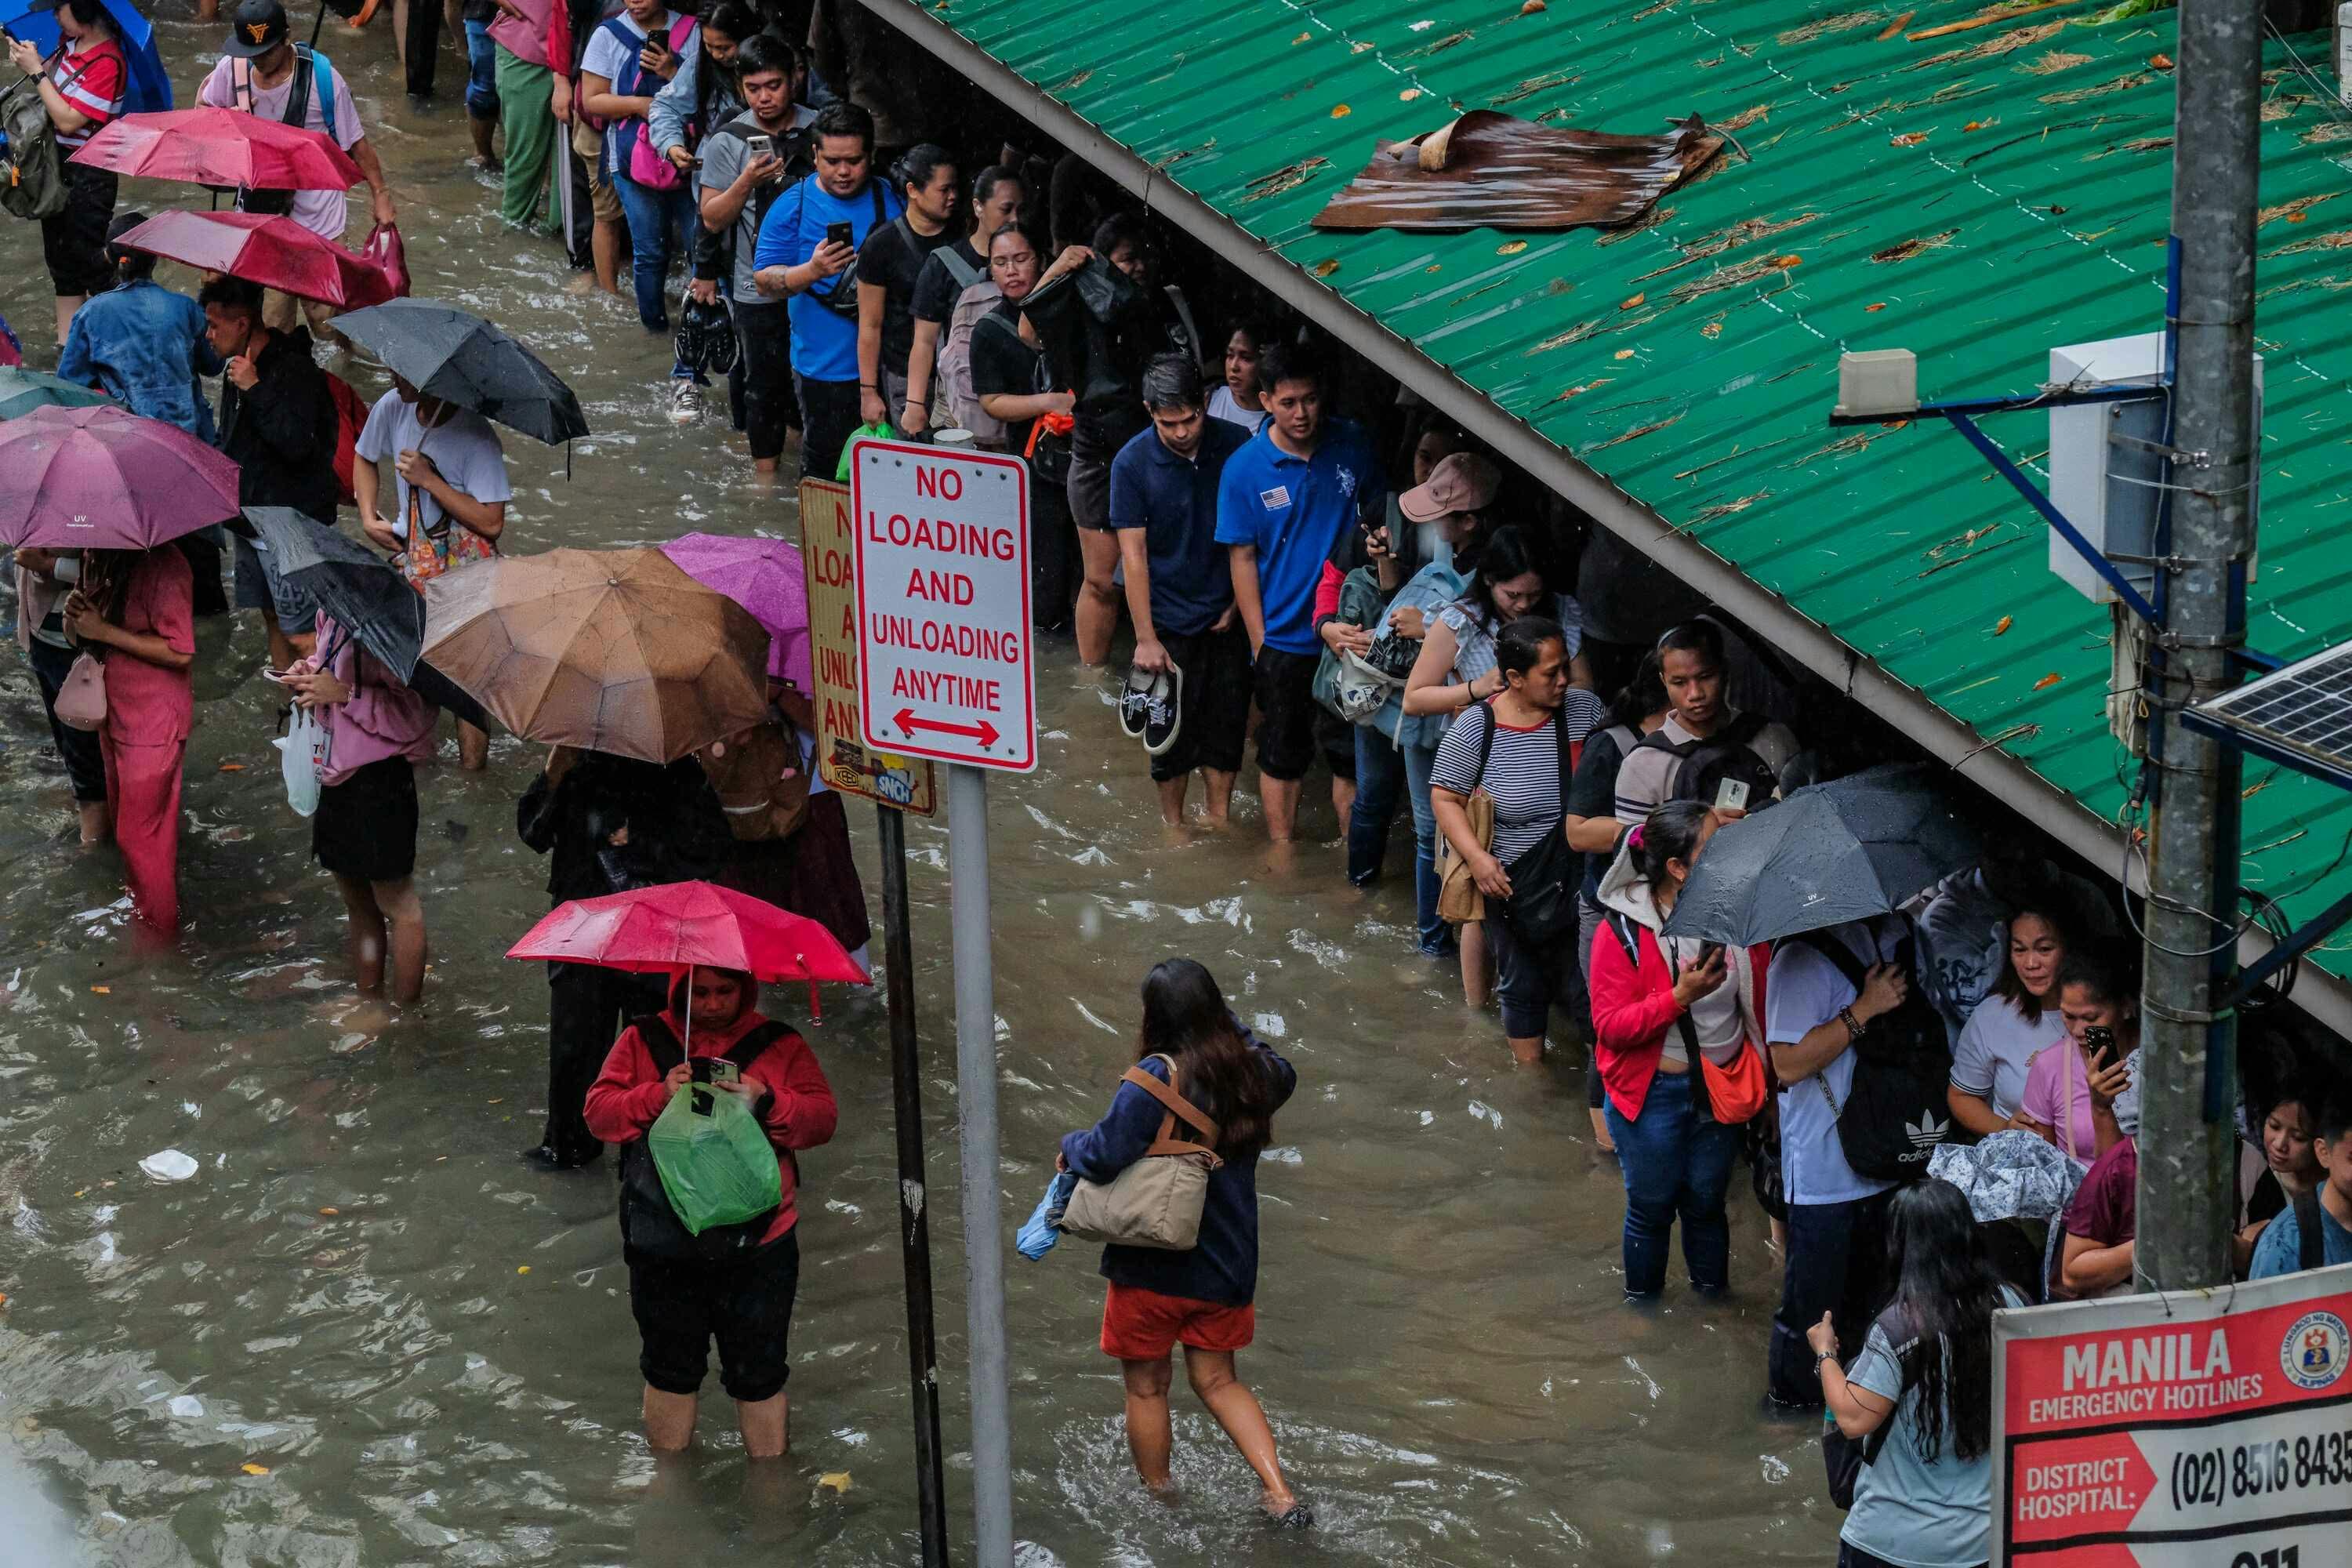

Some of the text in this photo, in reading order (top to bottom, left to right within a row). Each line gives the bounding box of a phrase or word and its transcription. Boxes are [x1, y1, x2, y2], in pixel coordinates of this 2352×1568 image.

[916, 465, 963, 501] NO
[74, 514, 87, 522] UV
[869, 511, 1014, 561] LOADING
[906, 568, 974, 605] AND
[873, 613, 1018, 663] UNLOADING
[892, 667, 1000, 712] ANYTIME
[2063, 1328, 2231, 1392] MANILA
[2029, 1374, 2263, 1423] EMERGENCY HOTLINES
[2027, 1457, 2129, 1491] DISTRICT
[2172, 1447, 2225, 1511] (02)
[2232, 1439, 2289, 1497] 8516
[2019, 1487, 2136, 1521] HOSPITAL:
